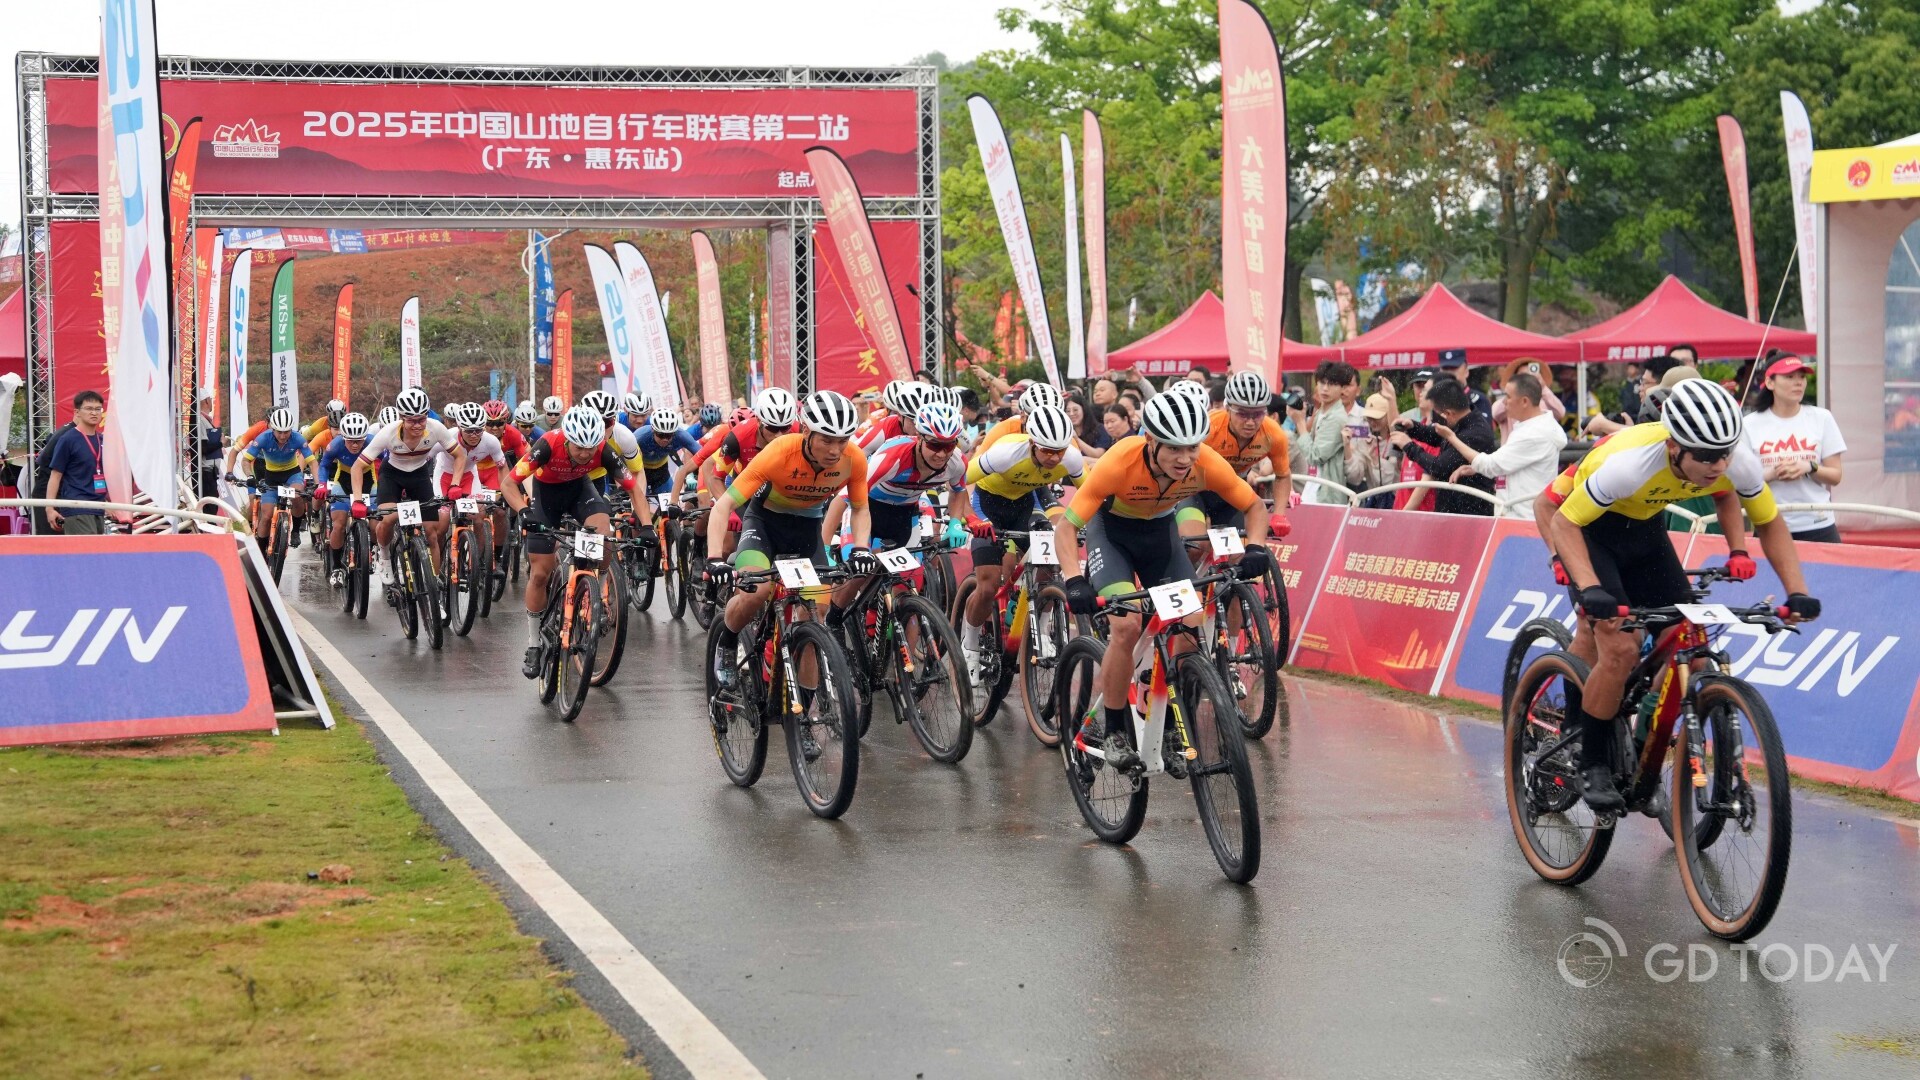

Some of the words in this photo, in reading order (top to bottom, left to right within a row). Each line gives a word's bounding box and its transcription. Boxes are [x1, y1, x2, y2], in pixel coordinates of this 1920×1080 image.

[303, 110, 850, 141] 2025年中国山地自行车联赛第二站
[778, 172, 815, 188] 起点
[1759, 433, 1818, 455] CML
[402, 508, 417, 520] 34
[580, 542, 597, 553] 12
[1040, 541, 1051, 556] 2
[1220, 536, 1229, 548] 7
[888, 555, 908, 568] 10
[1344, 552, 1460, 584] 锚定高质量发展首要任务
[794, 567, 803, 580] 1
[1324, 574, 1460, 612] 建设绿色发展美丽幸福示范县
[1168, 593, 1183, 609] 5
[1702, 610, 1718, 620] 4
